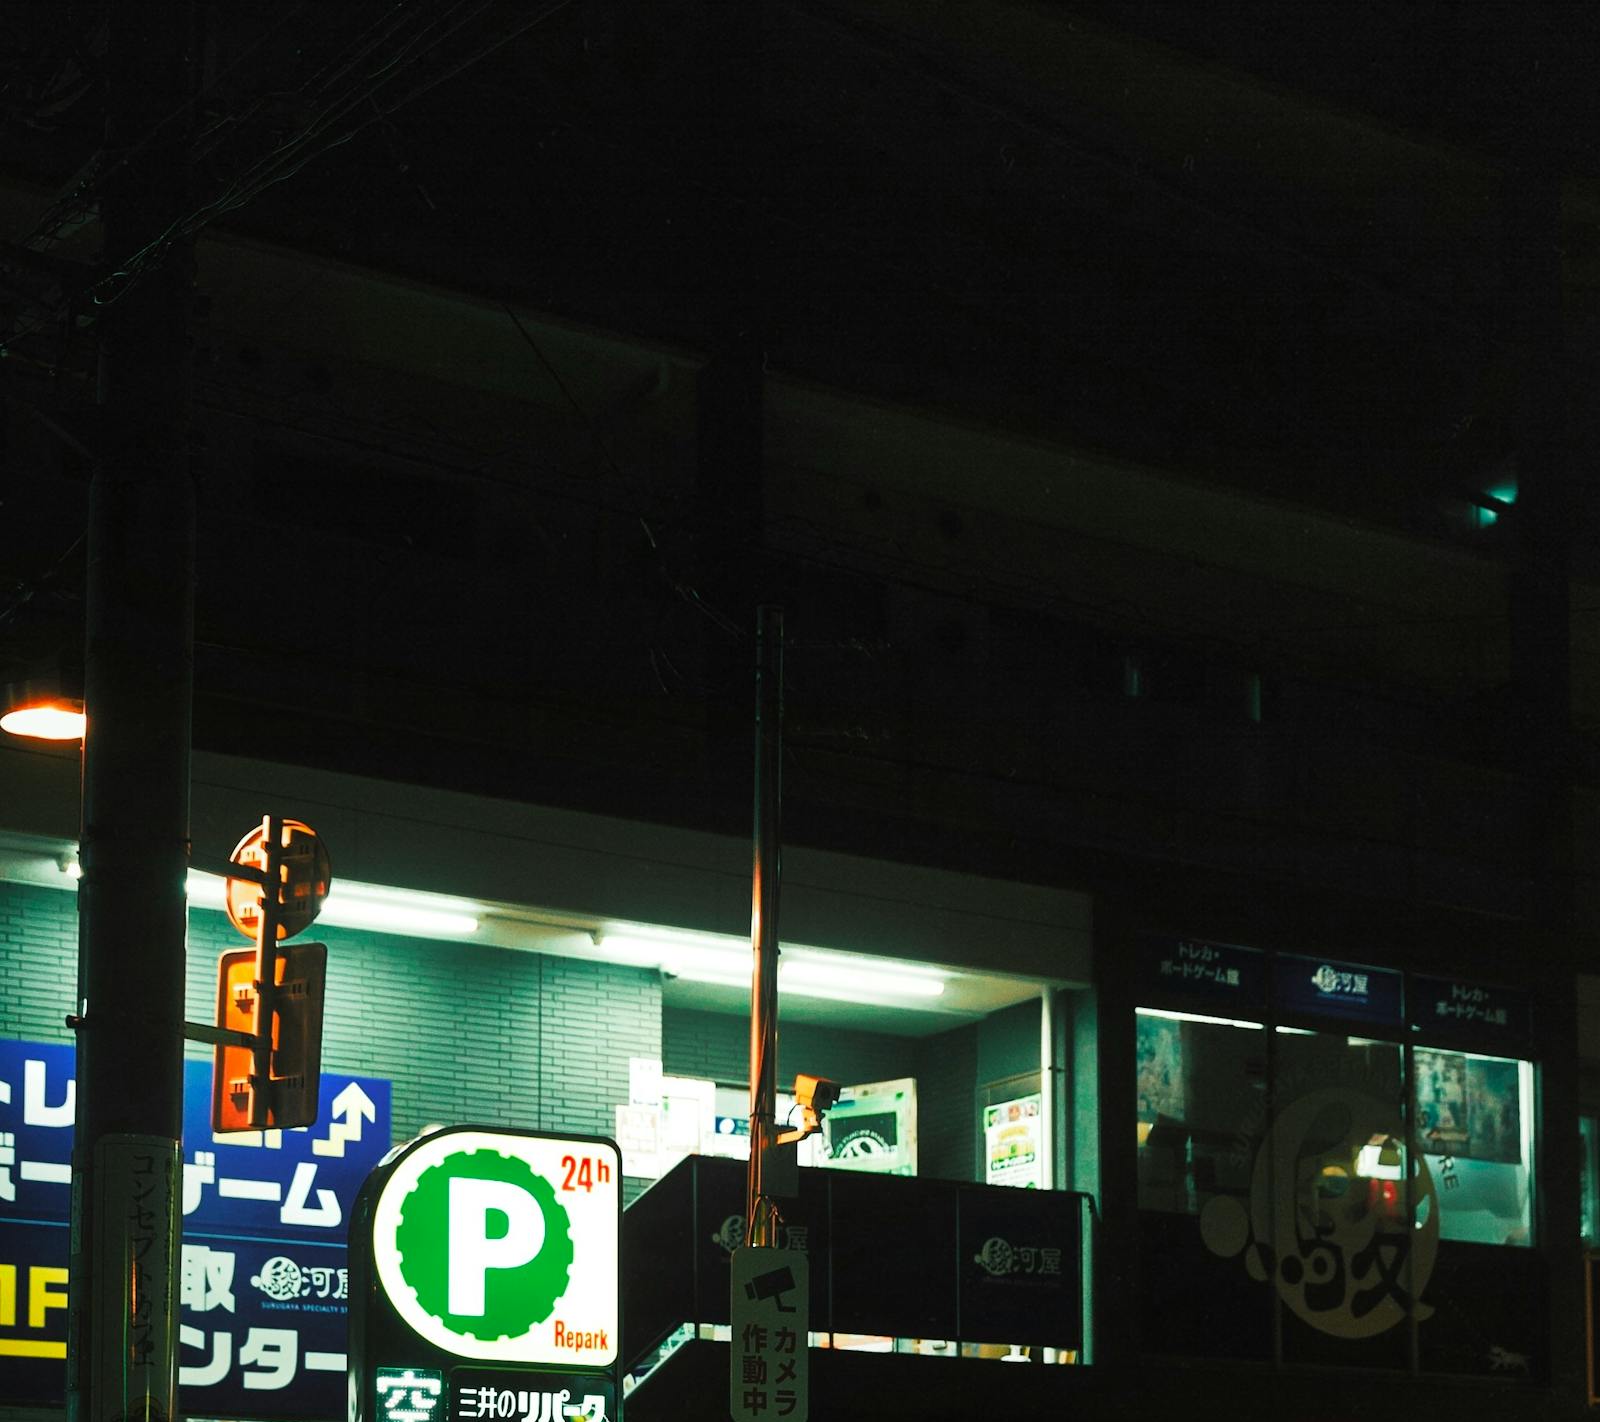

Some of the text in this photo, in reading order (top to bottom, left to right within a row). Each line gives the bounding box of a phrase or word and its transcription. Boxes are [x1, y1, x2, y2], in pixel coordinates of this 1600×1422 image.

[561, 1155, 611, 1193] 24h
[448, 1176, 546, 1317] P
[554, 1320, 609, 1352] Repark
[742, 1322, 768, 1418] 作動中
[774, 1322, 798, 1417] カメラ
